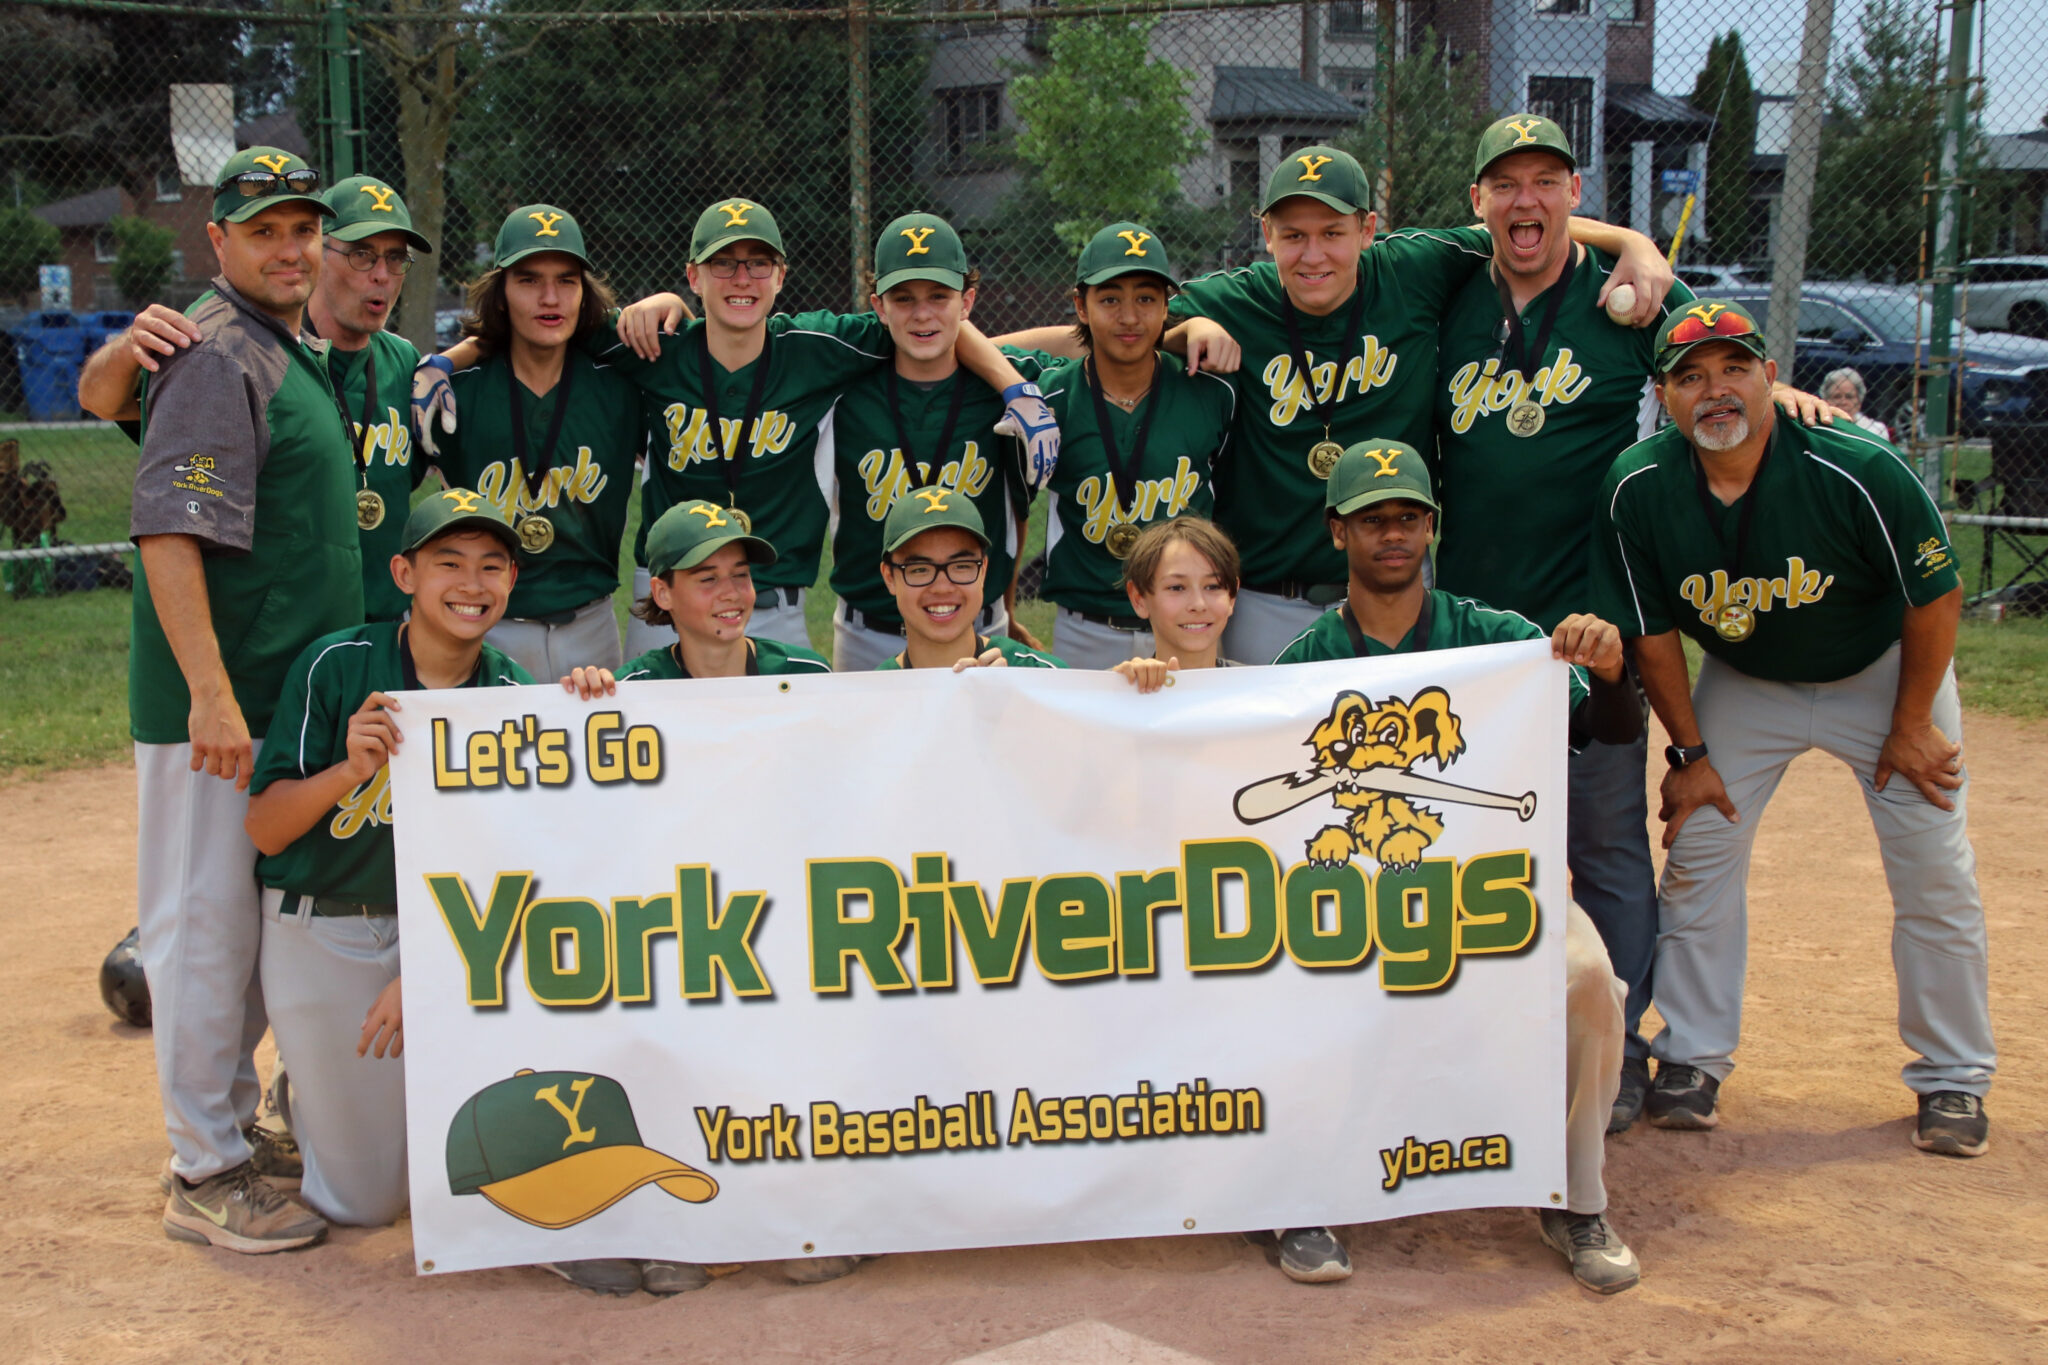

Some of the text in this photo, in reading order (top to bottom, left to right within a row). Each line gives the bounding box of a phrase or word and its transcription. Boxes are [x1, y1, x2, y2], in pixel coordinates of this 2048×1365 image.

[1506, 118, 1542, 147] Y
[1296, 154, 1334, 182] Y
[359, 184, 395, 213] Y
[528, 210, 564, 238] Y
[718, 202, 754, 228] Y
[900, 226, 937, 255] Y
[1116, 229, 1152, 258] Y
[1686, 303, 1727, 327] Y
[1263, 335, 1398, 427] York
[1448, 348, 1592, 434] York
[1364, 447, 1403, 478] Y
[172, 480, 188, 489] York
[442, 489, 483, 513] Y
[915, 488, 953, 514] Y
[688, 503, 727, 529] Y
[1680, 556, 1835, 627] York
[431, 711, 664, 789] Let's Go
[422, 836, 1537, 1006] York RiverDogs
[534, 1076, 597, 1151] Y
[693, 1077, 1265, 1161] York Baseball Association
[1379, 1133, 1513, 1192] yba.ca
